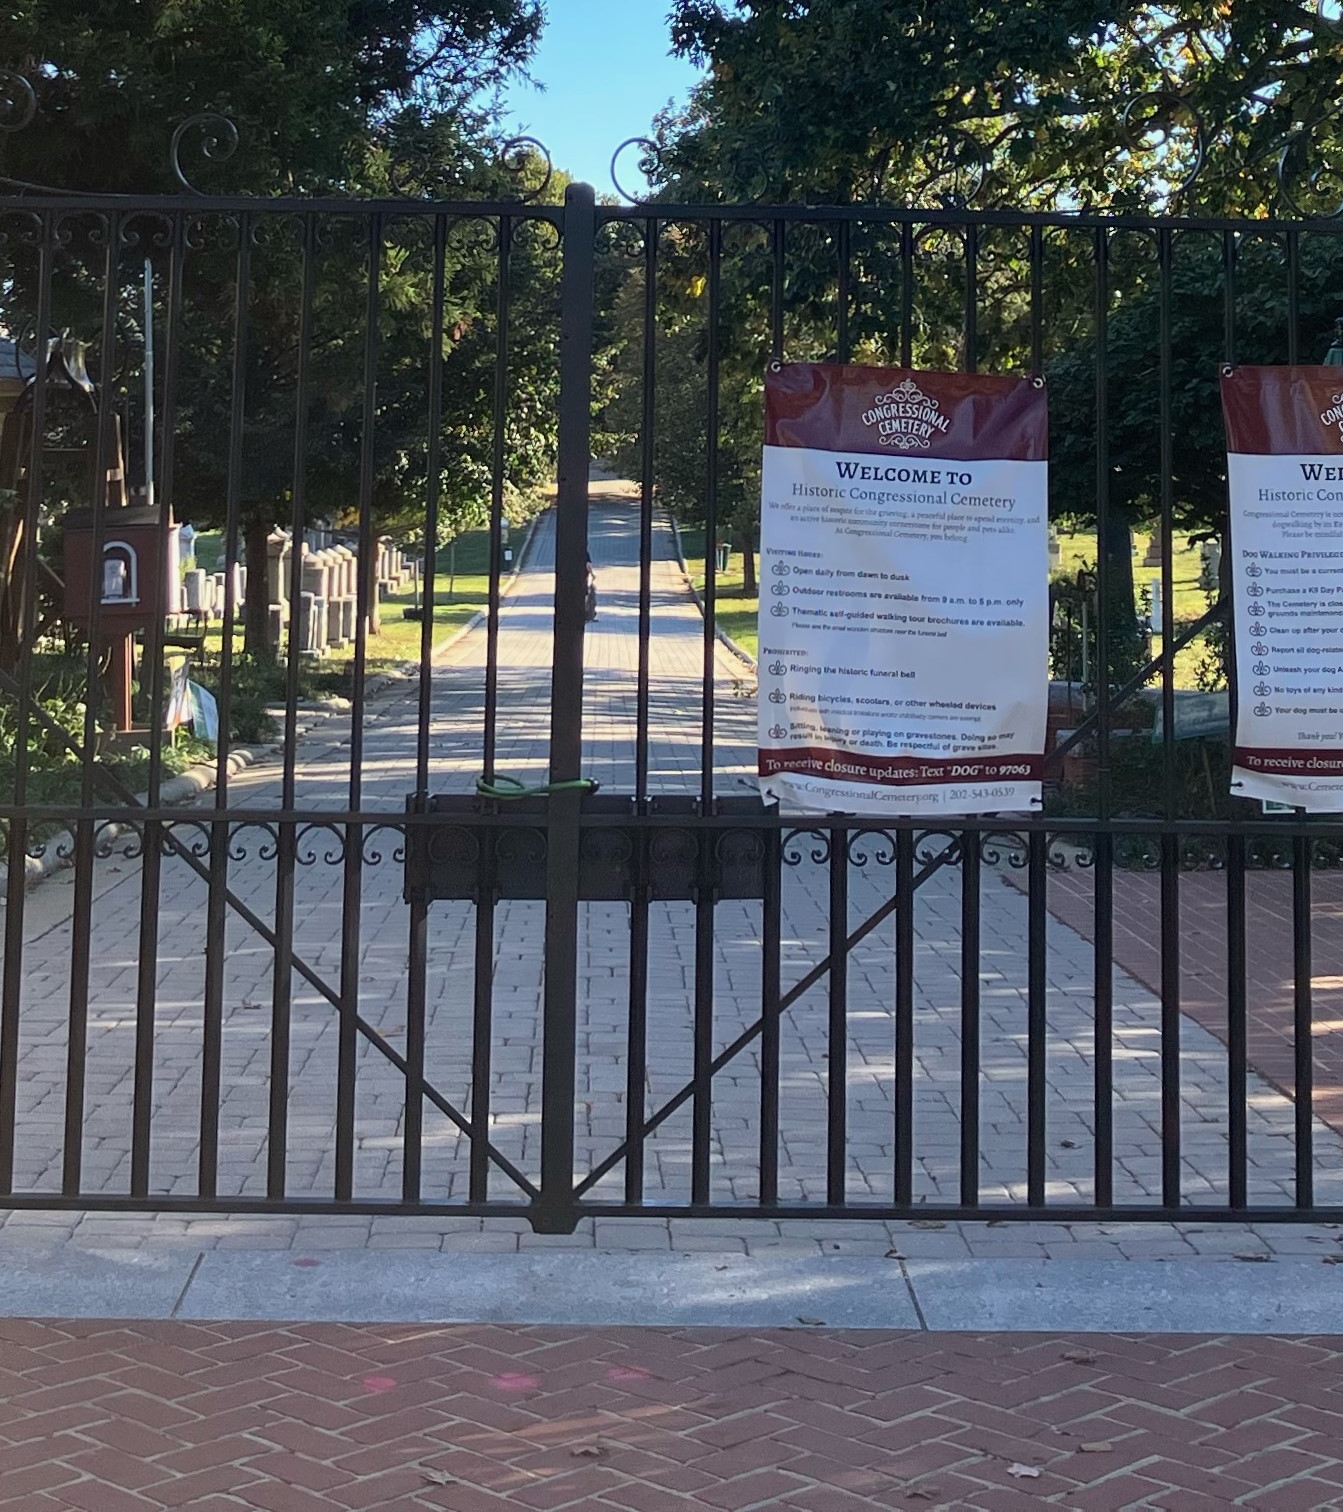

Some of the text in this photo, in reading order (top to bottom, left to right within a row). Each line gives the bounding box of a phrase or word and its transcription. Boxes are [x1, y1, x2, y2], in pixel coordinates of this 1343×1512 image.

[861, 402, 951, 433] CONGRESSIONAL
[878, 418, 936, 438] CEMETERY
[836, 462, 941, 484] WELCOME
[792, 483, 1016, 512] Historic Congressional Cemetery
[1258, 488, 1314, 501] Historic
[792, 566, 910, 581] Open daily from dawn to dusk
[792, 585, 824, 596] Outdoor
[826, 588, 867, 598] restrooms
[884, 592, 919, 602] available
[921, 594, 940, 603] from
[968, 597, 977, 605] to
[1006, 598, 1025, 607] only
[1320, 587, 1335, 595] Day
[1267, 600, 1281, 608] The
[1282, 600, 1318, 609] Cemetery
[792, 607, 828, 617] Thematic
[829, 610, 875, 620] self-guided
[876, 611, 907, 623] walking
[908, 615, 925, 623] tour
[927, 616, 970, 626] brochures
[986, 618, 1026, 628] available.
[1267, 610, 1299, 619] grounds
[1269, 626, 1290, 634] Clean
[1291, 627, 1301, 635] up
[1302, 626, 1319, 634] after
[1321, 627, 1338, 635] your
[790, 664, 916, 679] Ringing the historic funeral bell
[789, 692, 816, 703] Riding
[817, 694, 854, 705] bicycles,
[905, 699, 928, 708] other
[928, 700, 963, 710] wheeled
[964, 701, 997, 711] devices
[789, 732, 813, 741] result
[814, 732, 823, 741] in
[848, 738, 859, 746] or
[886, 740, 898, 748] Be
[899, 741, 940, 750] respectful
[942, 742, 952, 750] of
[952, 744, 976, 753] grave
[862, 728, 892, 739] playing
[960, 732, 986, 743] Doing
[998, 732, 1016, 741] may
[765, 758, 781, 770] To
[783, 757, 823, 770] receive
[824, 758, 867, 775] closure
[868, 765, 919, 780] updates:
[919, 765, 945, 777] Text
[985, 766, 997, 775] to
[998, 764, 1031, 776] 97063
[1246, 755, 1262, 766] To
[1263, 756, 1304, 768] receive
[949, 786, 1015, 800] 202-543-0539
